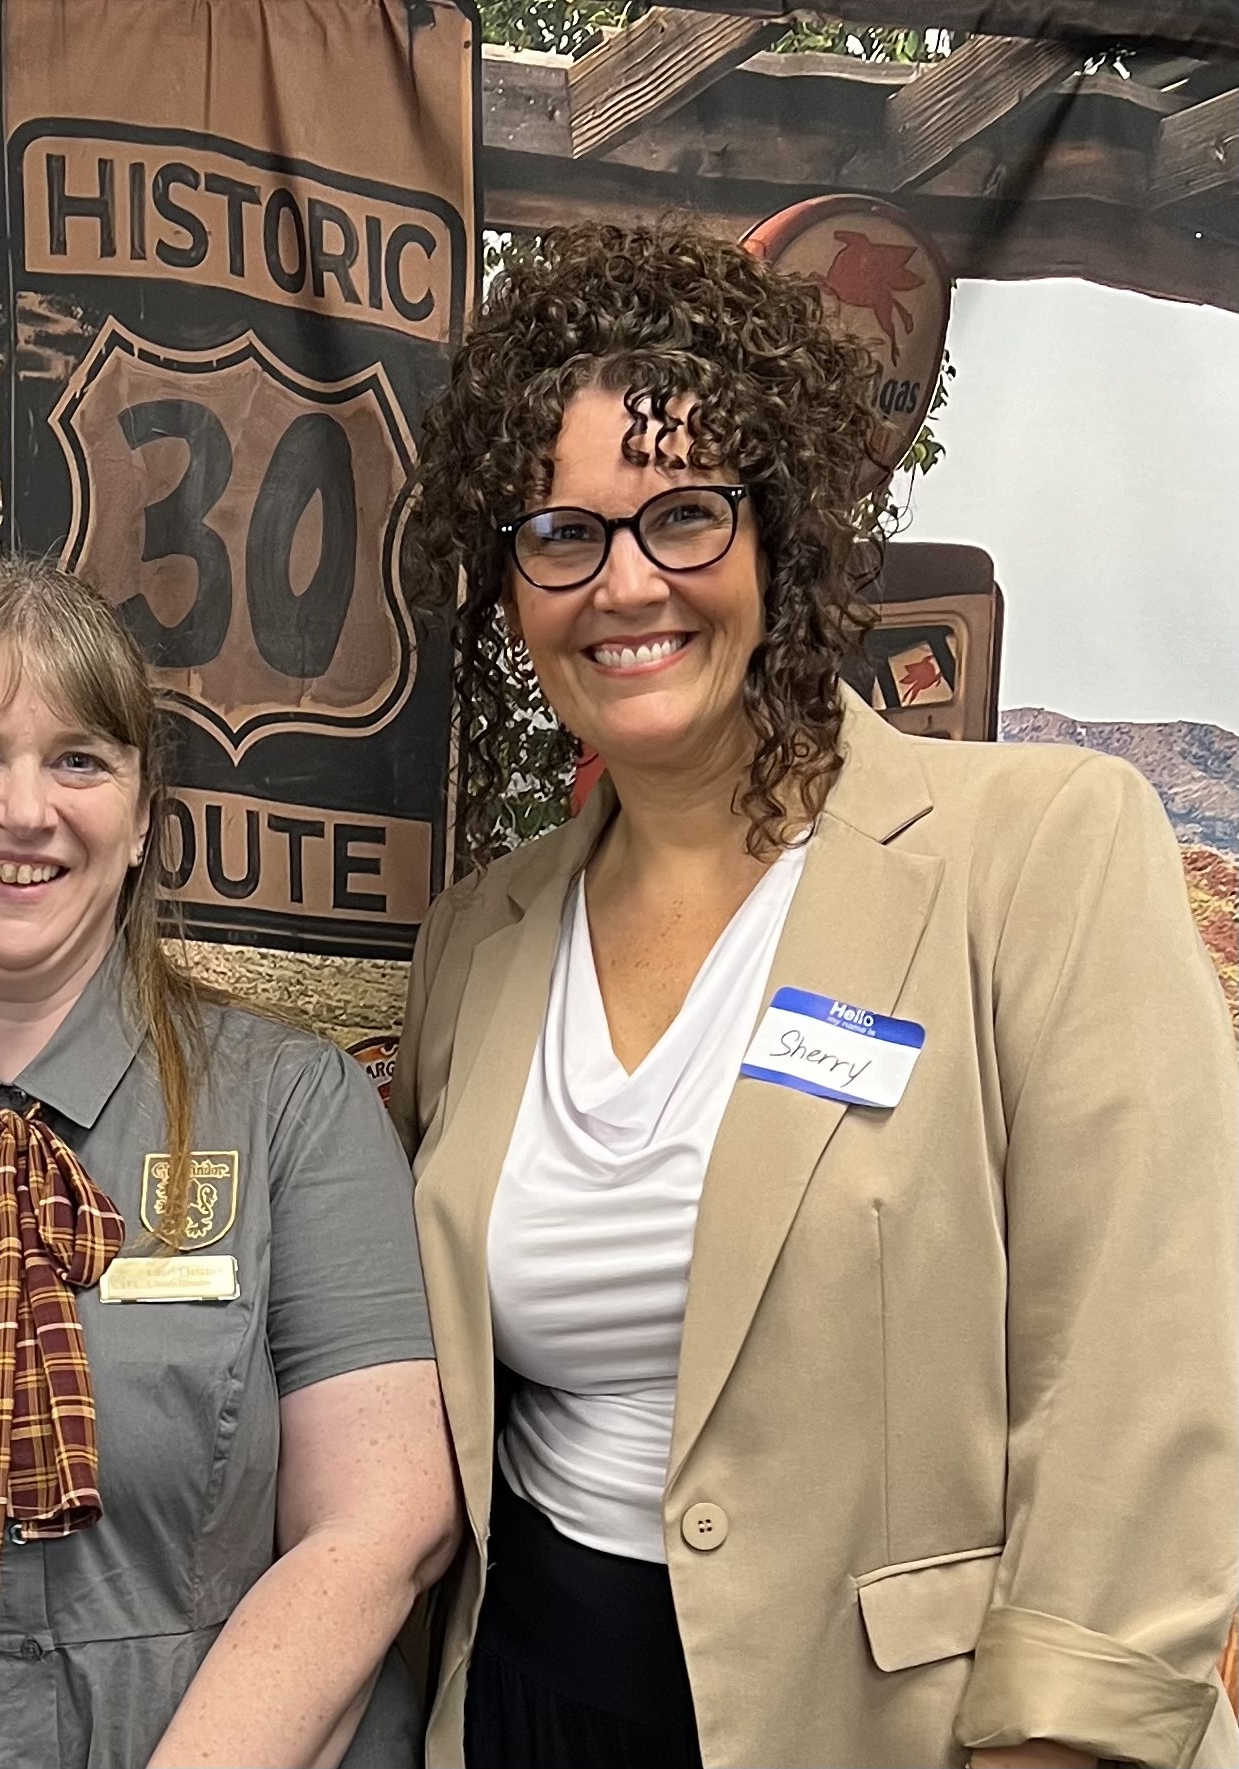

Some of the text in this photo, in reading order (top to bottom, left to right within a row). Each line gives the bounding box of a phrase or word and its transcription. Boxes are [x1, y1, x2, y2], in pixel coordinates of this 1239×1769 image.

[45, 153, 438, 322] HISTORIC
[878, 378, 921, 420] gas
[117, 399, 358, 680] 30
[158, 797, 388, 913] OUTE
[828, 1001, 875, 1028] Hello
[769, 1029, 873, 1089] Sherry
